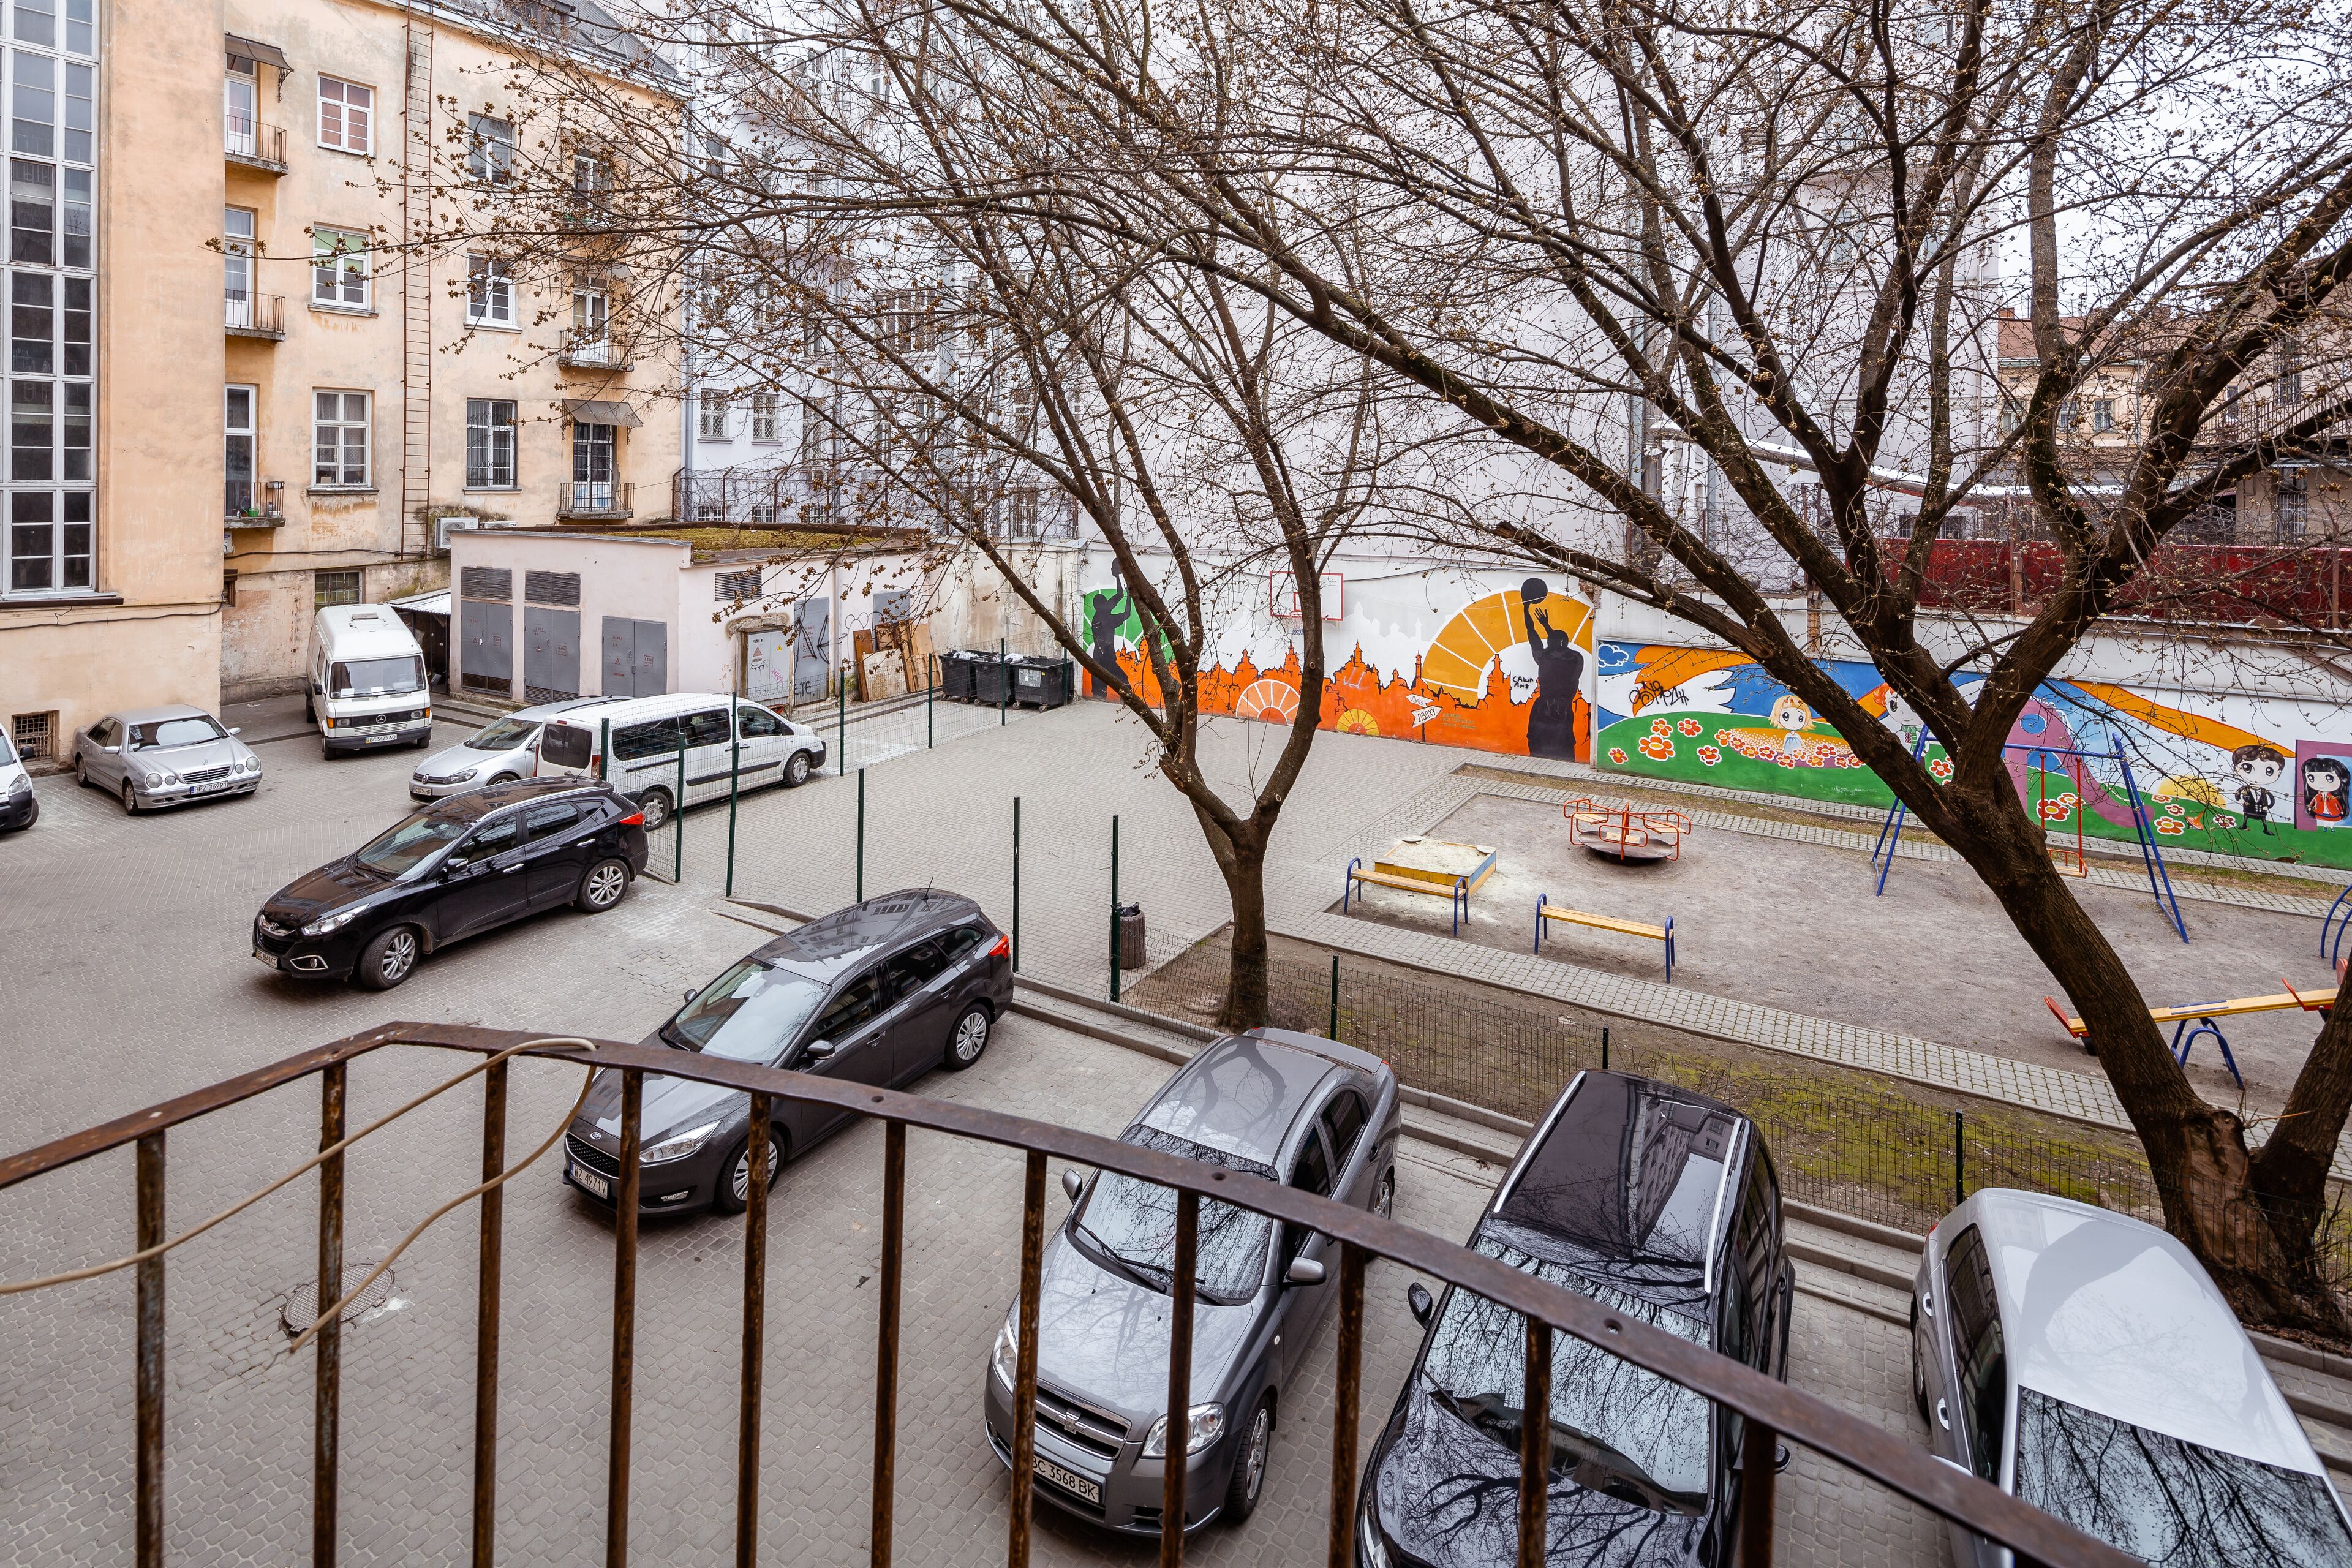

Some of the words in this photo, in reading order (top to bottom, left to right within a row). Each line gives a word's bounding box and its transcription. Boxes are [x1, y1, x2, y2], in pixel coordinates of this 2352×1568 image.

[1417, 708, 1436, 722] ЛВПХУ
[574, 1165, 582, 1181] WZ
[584, 1174, 606, 1194] 4971V
[1049, 1464, 1076, 1488] 3568
[1079, 1479, 1096, 1500] BK
